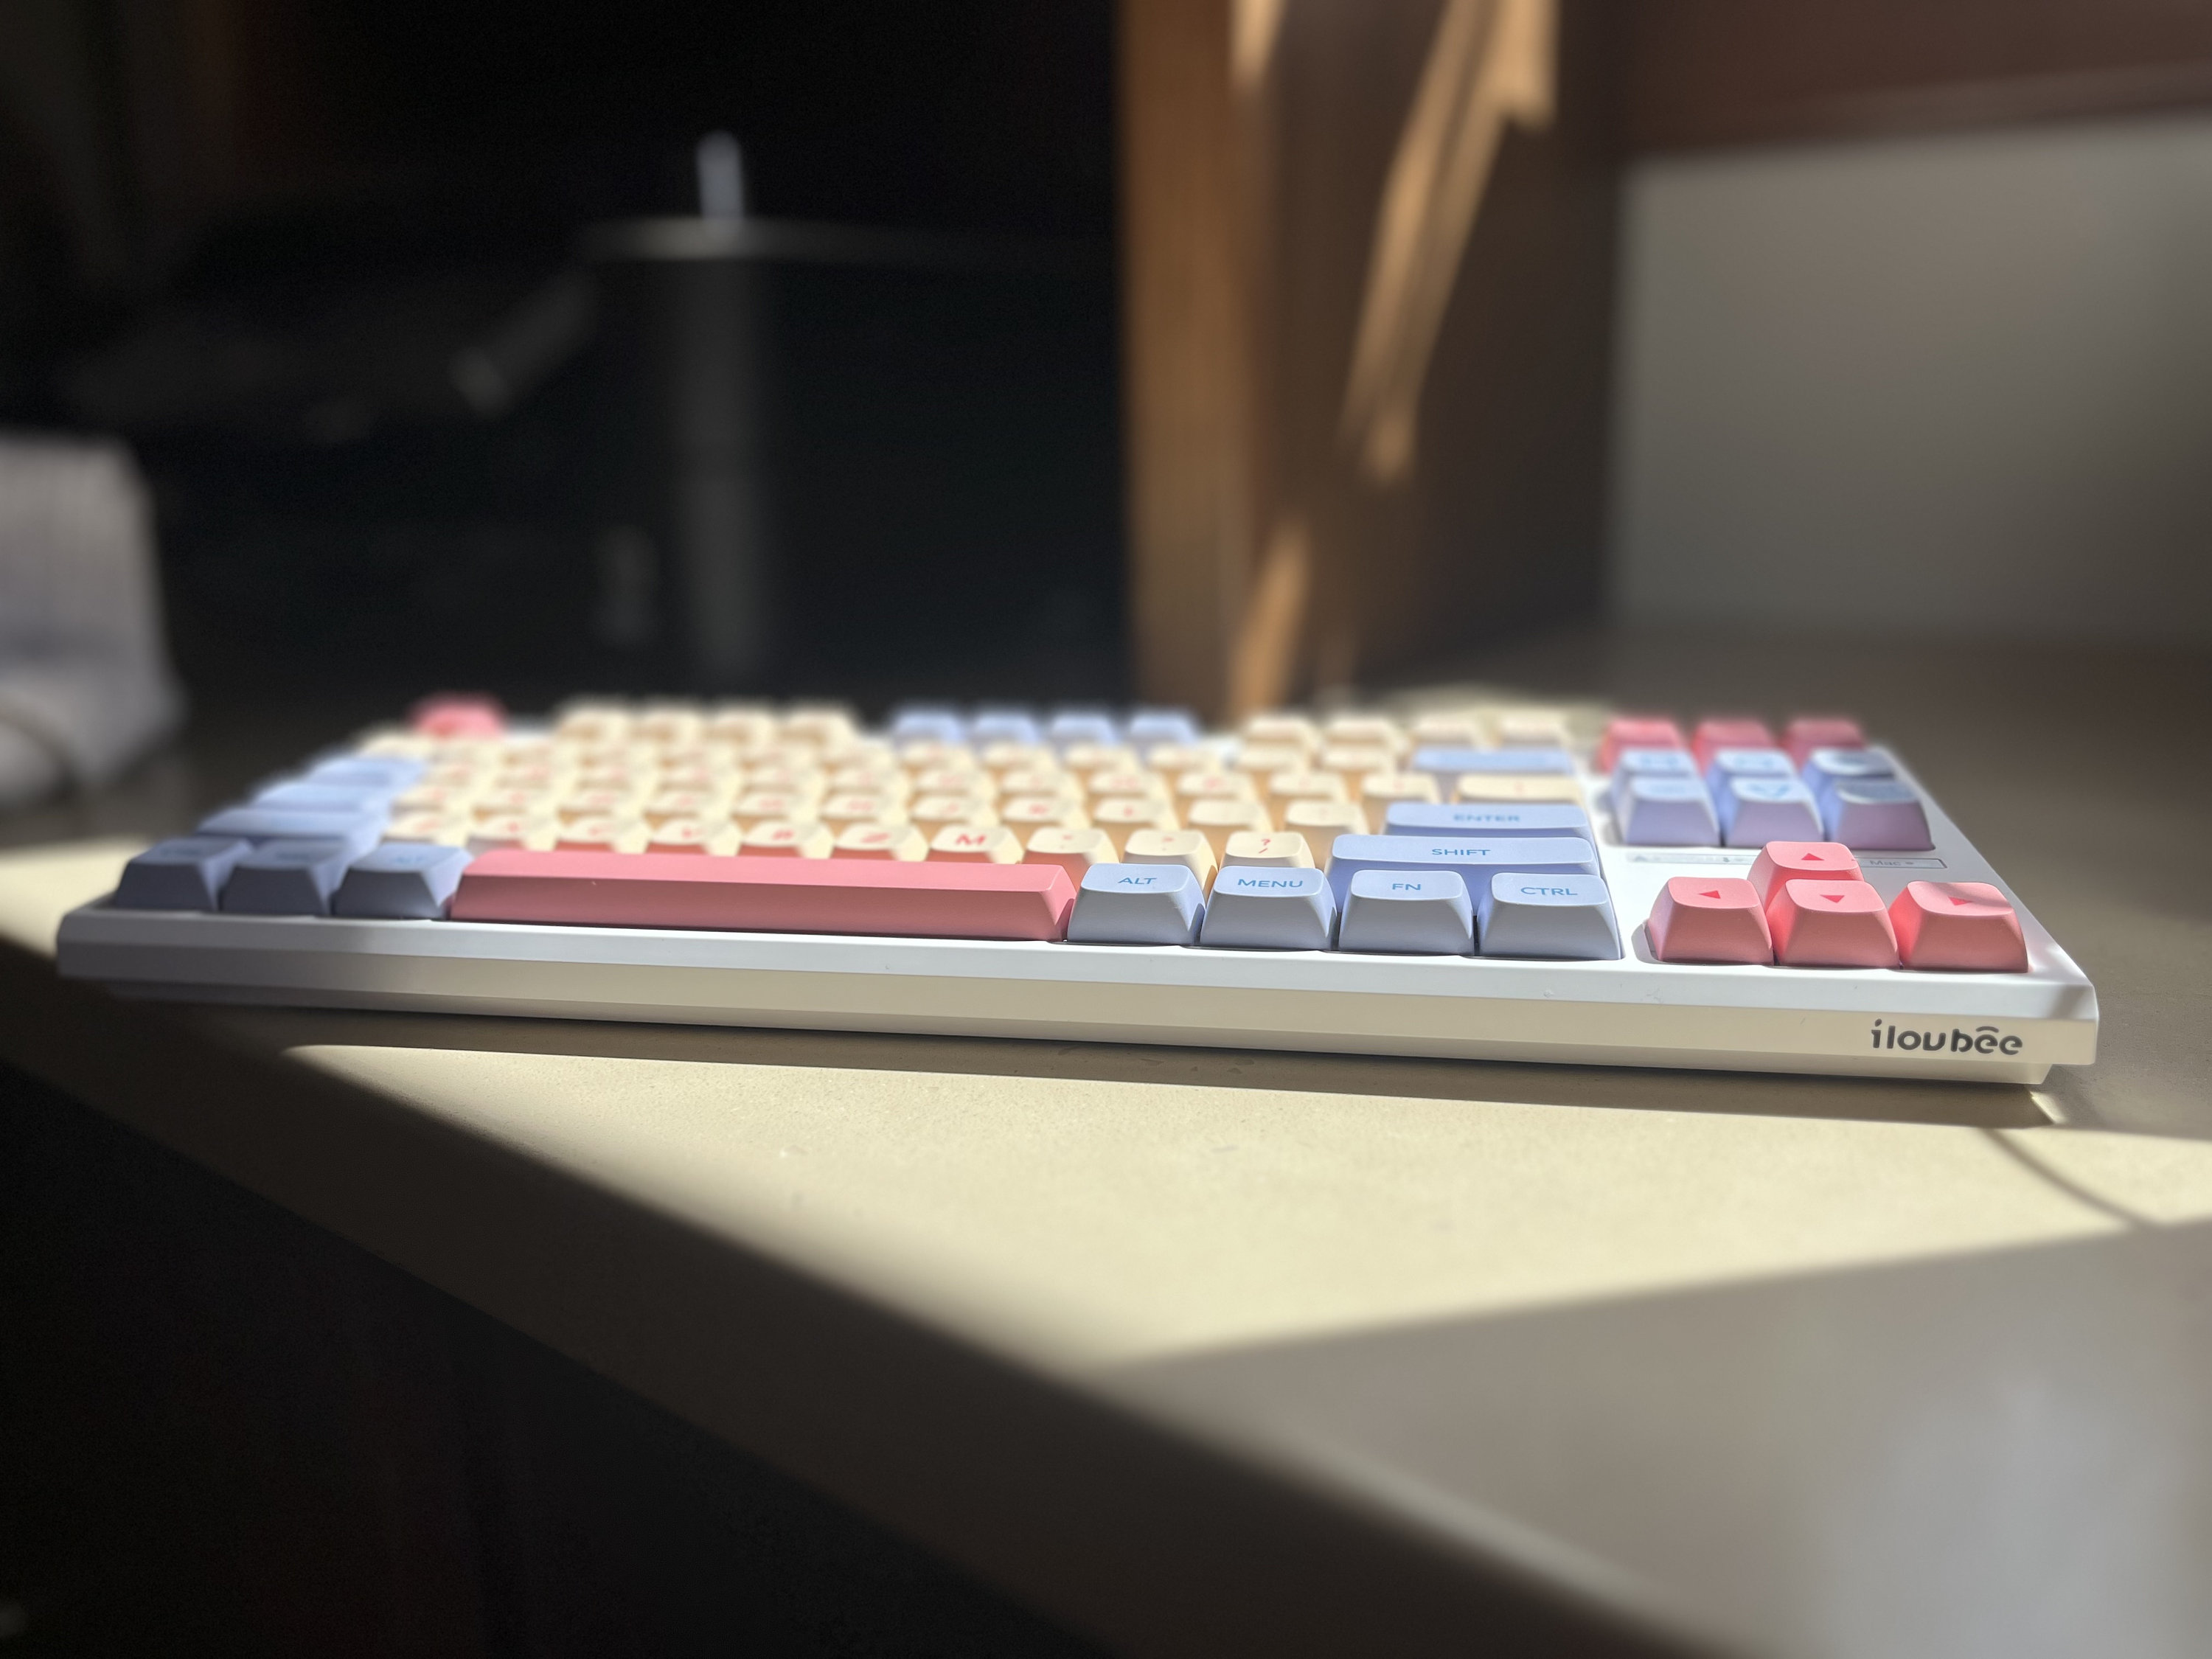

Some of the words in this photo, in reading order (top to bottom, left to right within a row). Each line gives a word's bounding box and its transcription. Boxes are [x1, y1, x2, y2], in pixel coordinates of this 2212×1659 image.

[1453, 814, 1520, 822] ENTER
[1237, 878, 1304, 888] MENU
[1391, 883, 1422, 891] FN
[1520, 887, 1578, 896] CTRL
